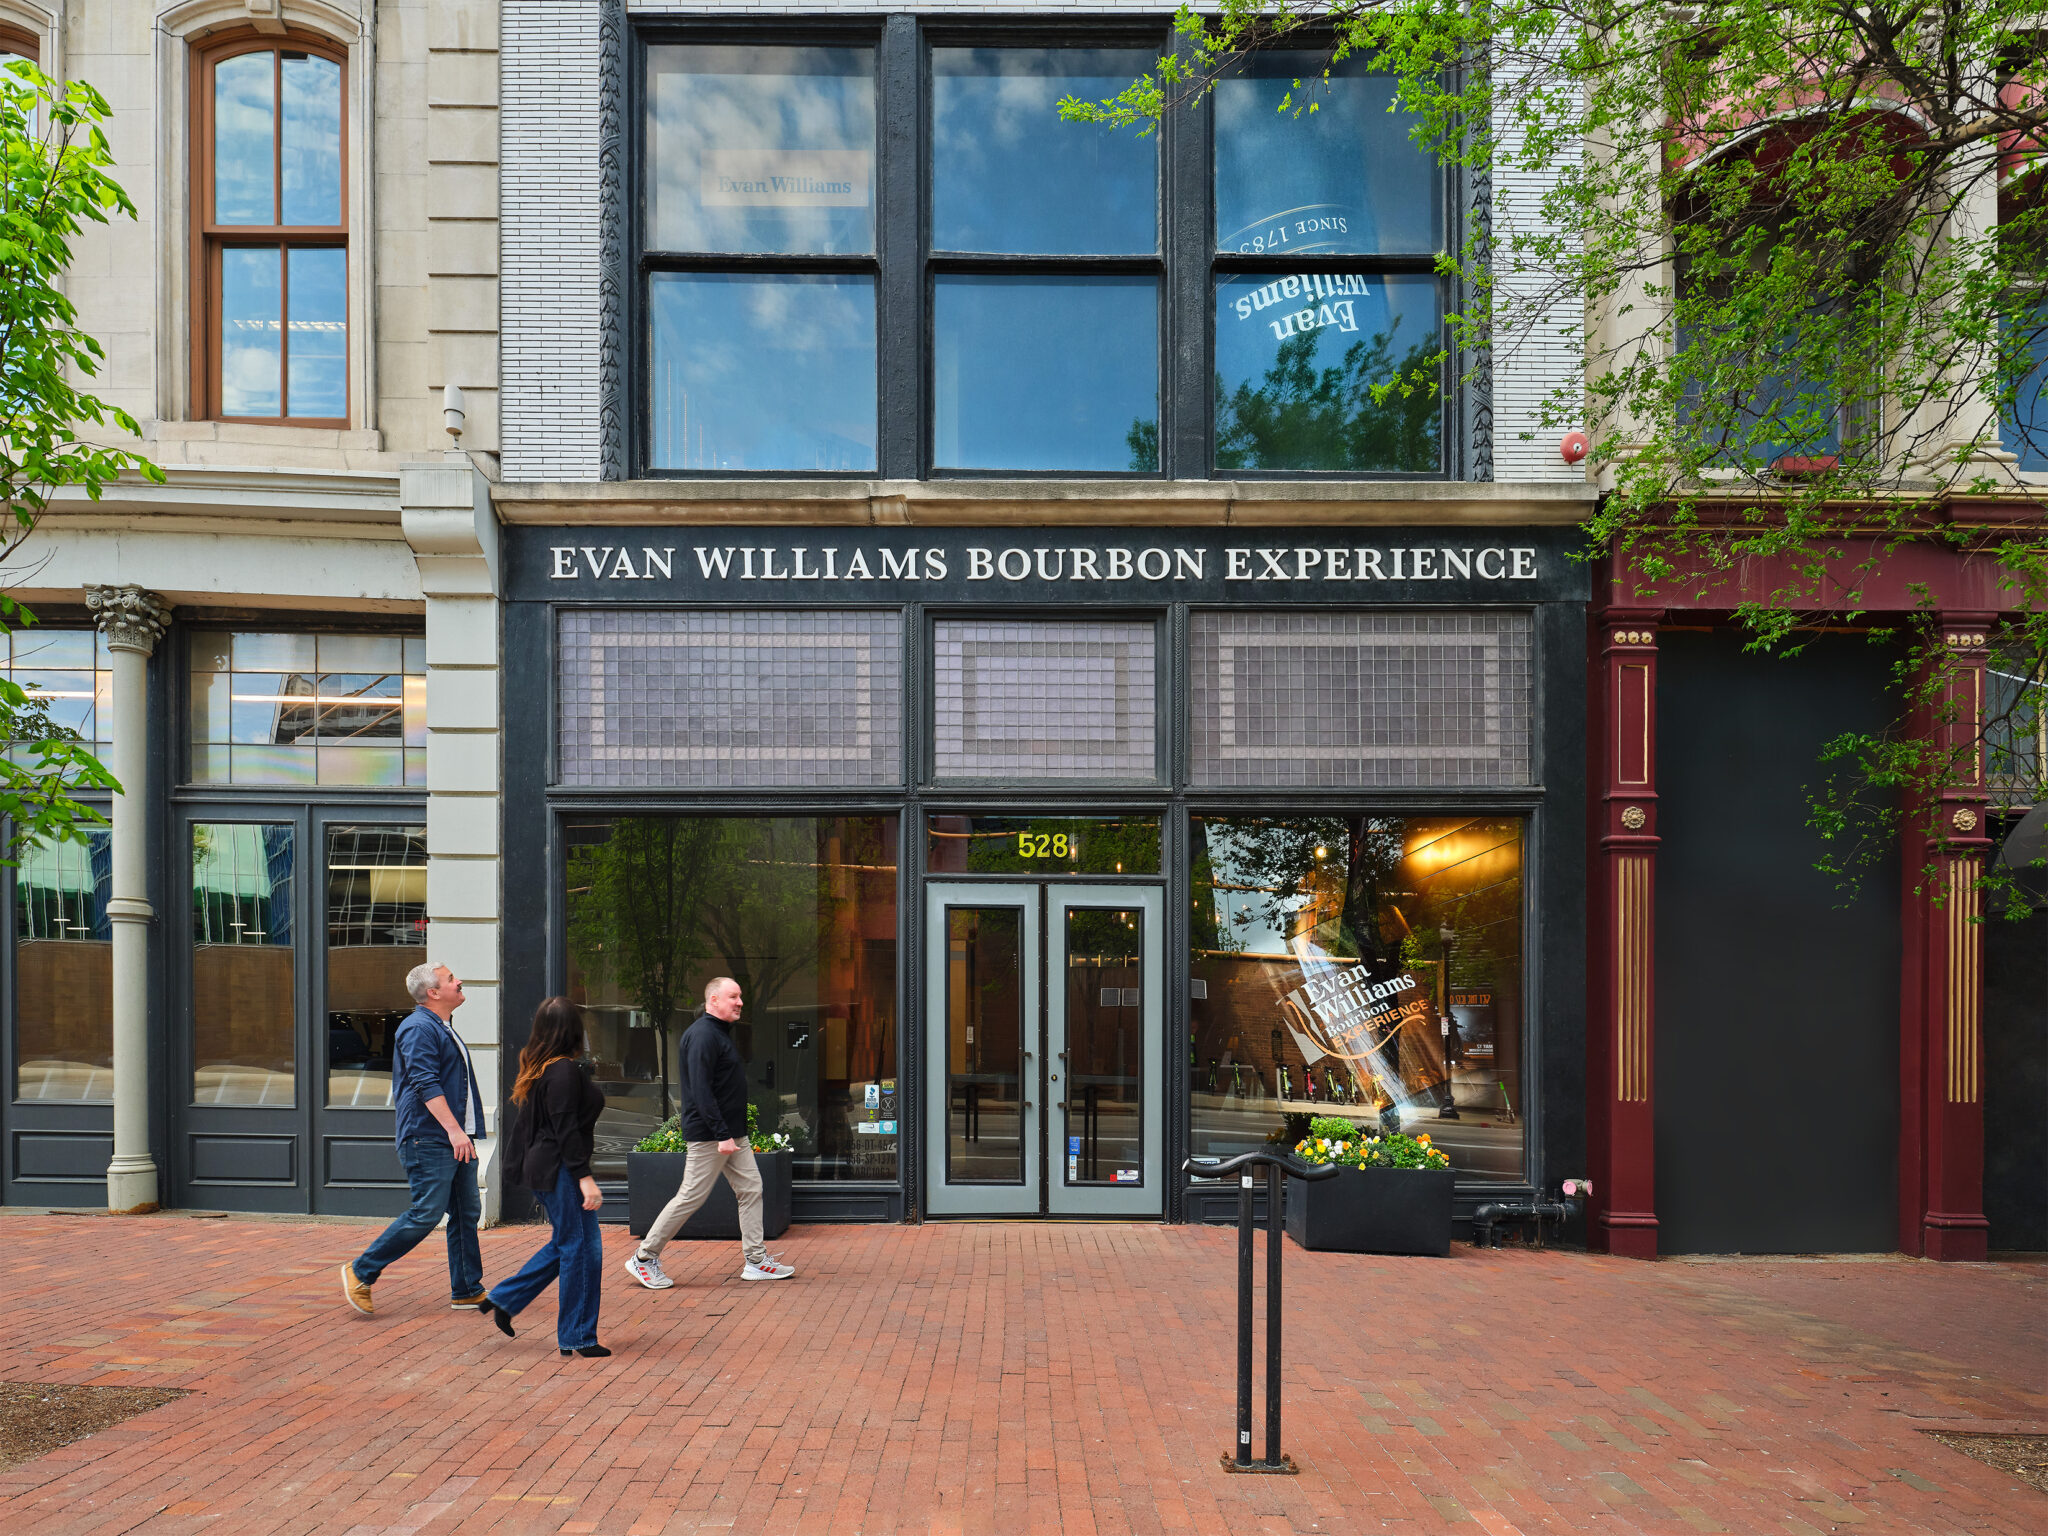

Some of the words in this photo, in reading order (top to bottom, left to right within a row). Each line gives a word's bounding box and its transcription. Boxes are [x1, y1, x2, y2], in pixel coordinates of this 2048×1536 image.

[717, 176, 768, 193] Evan
[770, 176, 852, 194] Williams
[1296, 217, 1348, 234] SINCE
[1269, 300, 1359, 341] Evan
[549, 546, 676, 580] EVAN
[693, 546, 949, 581] WILLIAMS
[966, 547, 1207, 581] BOURBON
[1224, 547, 1538, 581] EXPERIENCE
[1018, 833, 1068, 858] 528
[1300, 963, 1372, 1006] Evan
[1310, 973, 1416, 1025] Williams
[1325, 1001, 1391, 1039] Bourbon
[1331, 999, 1429, 1049] EXPERIENCE
